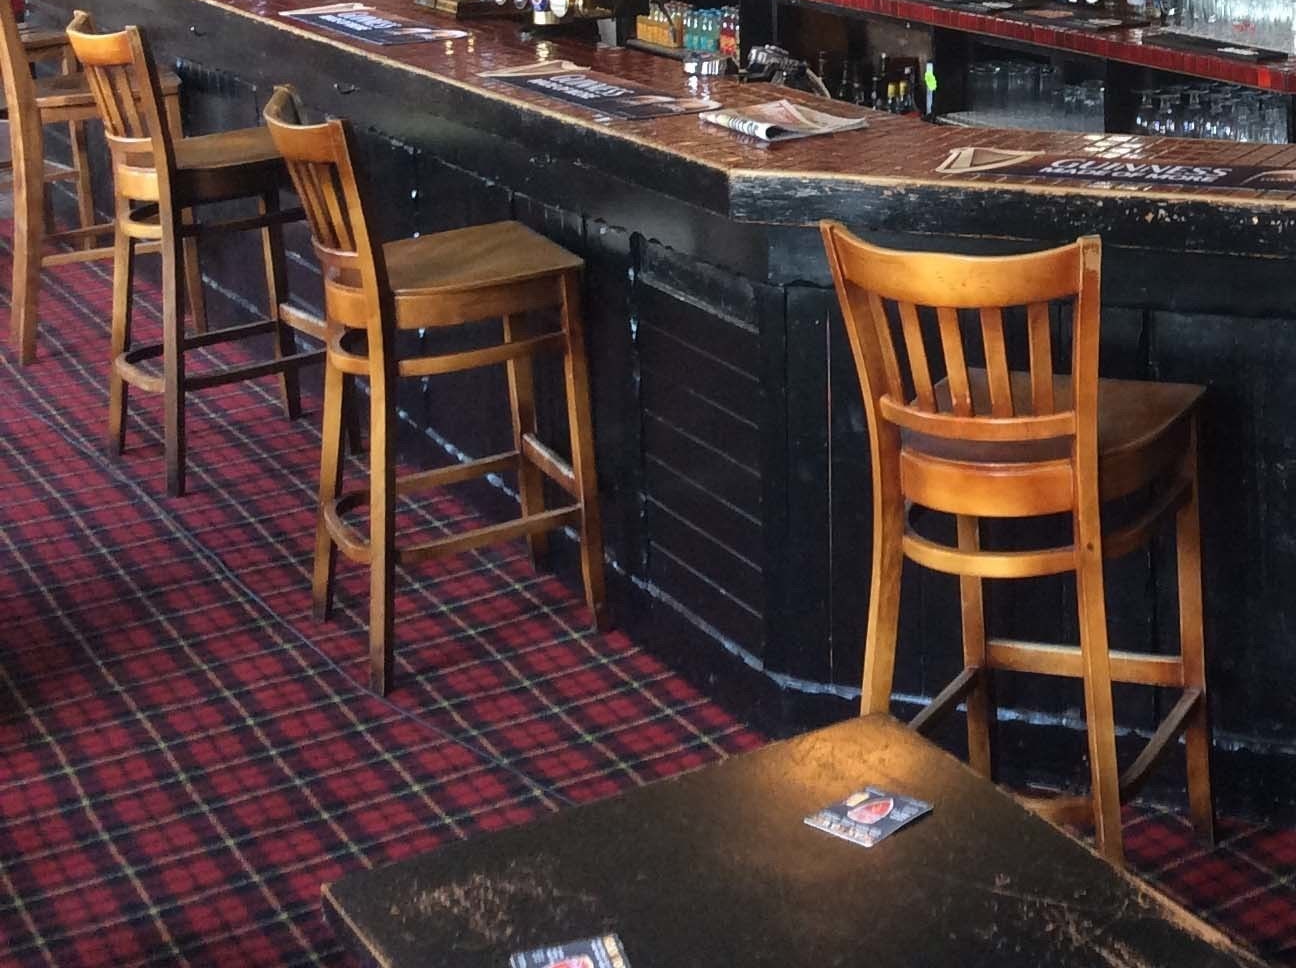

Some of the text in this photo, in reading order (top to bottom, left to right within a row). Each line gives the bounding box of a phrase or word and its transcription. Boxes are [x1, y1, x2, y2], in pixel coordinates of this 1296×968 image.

[1039, 167, 1108, 176] MADE
[1145, 174, 1220, 183] MORE
[1050, 158, 1232, 177] GUINNESS
